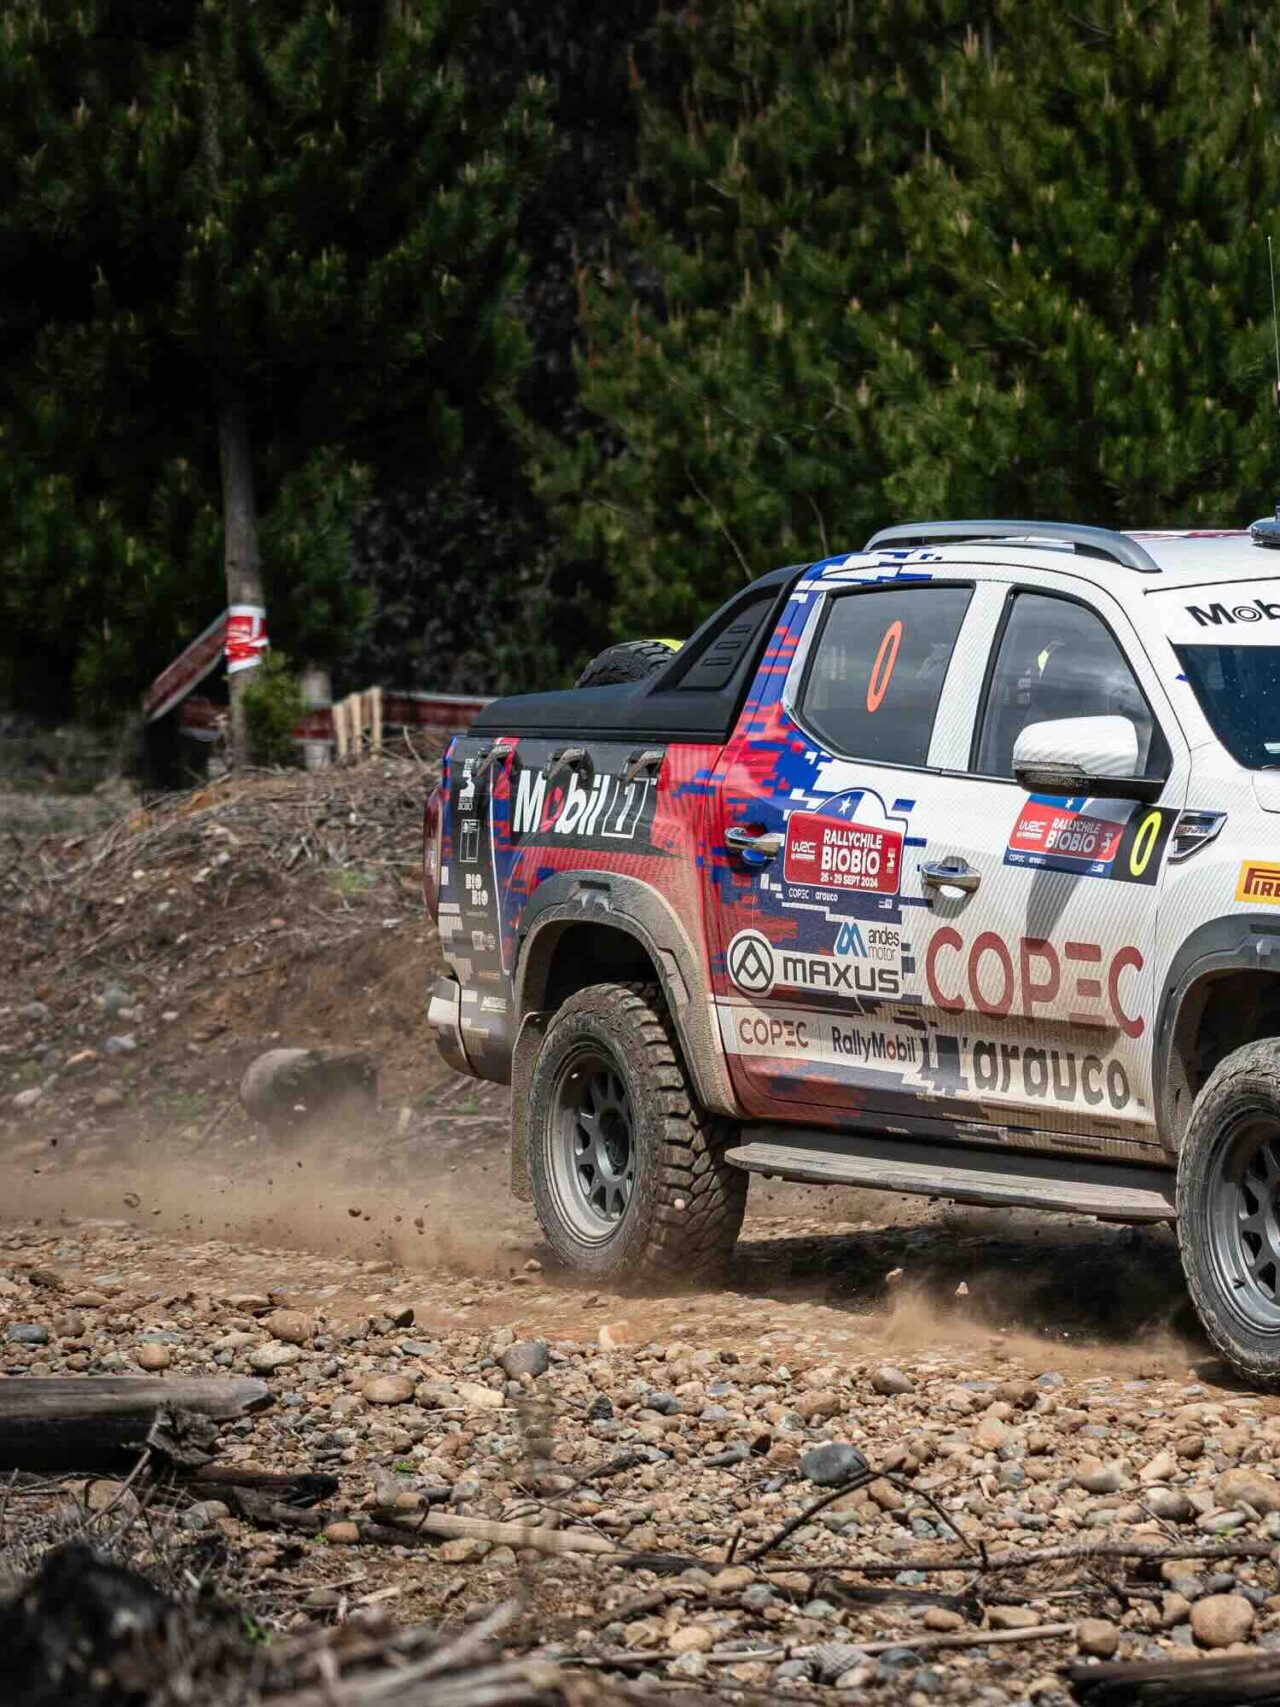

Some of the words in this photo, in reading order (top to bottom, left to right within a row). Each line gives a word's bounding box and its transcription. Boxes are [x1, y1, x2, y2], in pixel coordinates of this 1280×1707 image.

[513, 769, 611, 836] Mobil
[1050, 817, 1101, 835] RALLYCHILE
[791, 840, 816, 854] WRC
[823, 829, 883, 849] RALLYCHILE
[1129, 811, 1162, 877] 0
[843, 874, 860, 886] SEPT
[860, 876, 878, 888] 2024
[788, 887, 810, 900] COPEC
[815, 891, 838, 902] arauco
[868, 926, 900, 947] andes
[868, 946, 896, 962] motor
[783, 956, 899, 994] MAXUS
[925, 926, 1145, 1039] COPEC
[739, 1017, 809, 1049] COPEC
[831, 1025, 917, 1063] RallyMobil
[972, 1039, 1131, 1110] arauco
